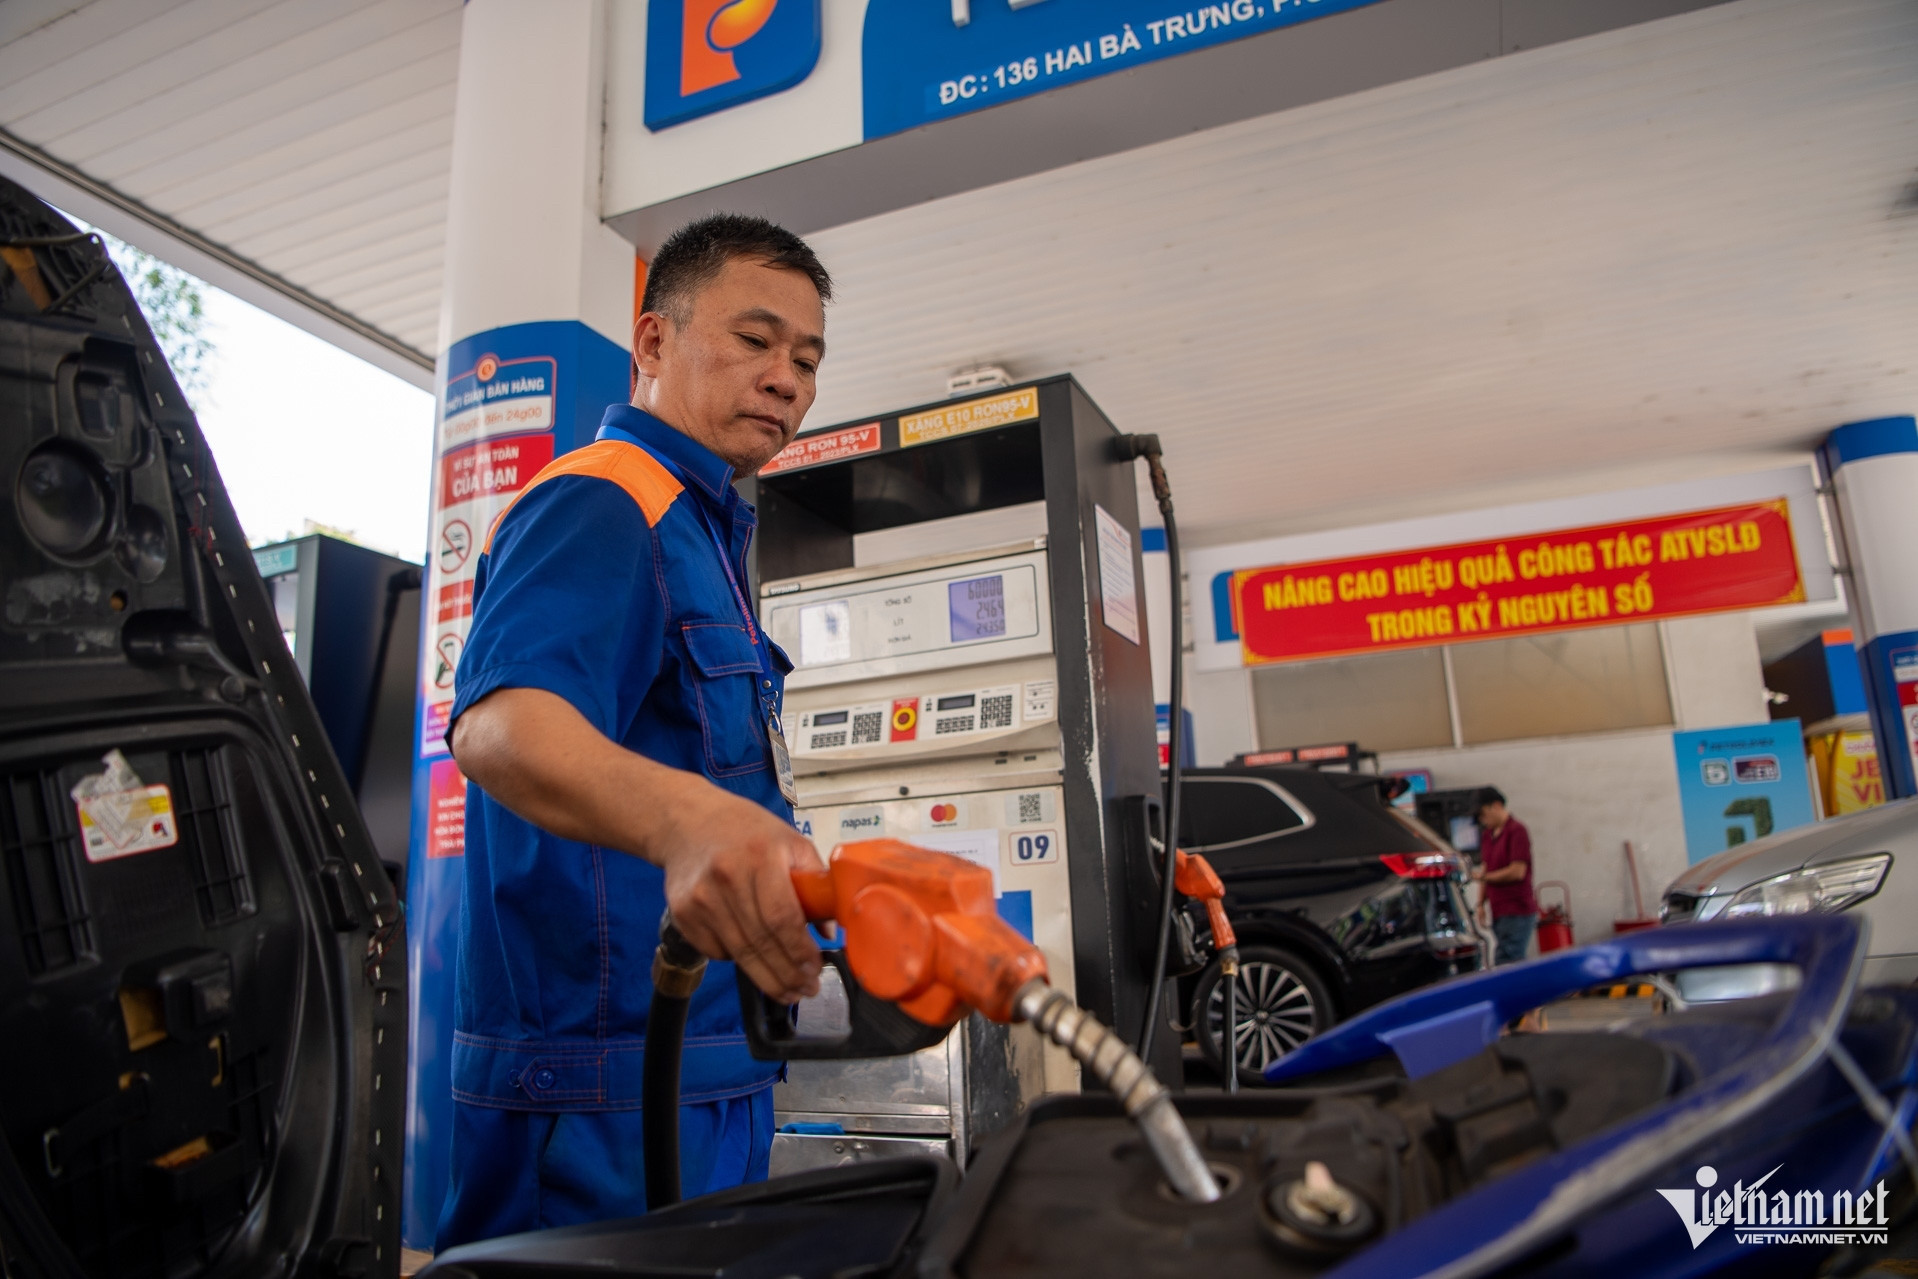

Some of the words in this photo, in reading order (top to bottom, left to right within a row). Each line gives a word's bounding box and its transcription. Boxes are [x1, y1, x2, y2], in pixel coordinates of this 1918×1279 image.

[993, 56, 1038, 88] 136
[1044, 40, 1093, 75] HAI
[1099, 23, 1142, 60] BÀ
[511, 376, 545, 393] HÀNG
[946, 409, 971, 425] E10
[493, 445, 519, 463] TOÀN
[807, 437, 837, 453] RON
[452, 468, 479, 497] CỦA
[484, 466, 518, 491] BẠN
[1262, 575, 1334, 611] NÂNG
[1337, 568, 1389, 602] CAO
[1393, 556, 1454, 598] HIỆU
[1458, 544, 1516, 590] QUẢ
[1517, 542, 1595, 580] CÔNG
[1597, 531, 1653, 570] TÁC
[1660, 520, 1761, 563] ATVSLĐ
[967, 577, 1003, 600] 60000
[735, 585, 759, 645] Petrolimex
[1365, 605, 1454, 643] TRONG
[1457, 591, 1492, 633] KỶ
[1497, 583, 1609, 628] NGUYÊN
[1613, 571, 1655, 615] SỐ
[842, 817, 872, 830] napas
[1017, 834, 1050, 860] 09
